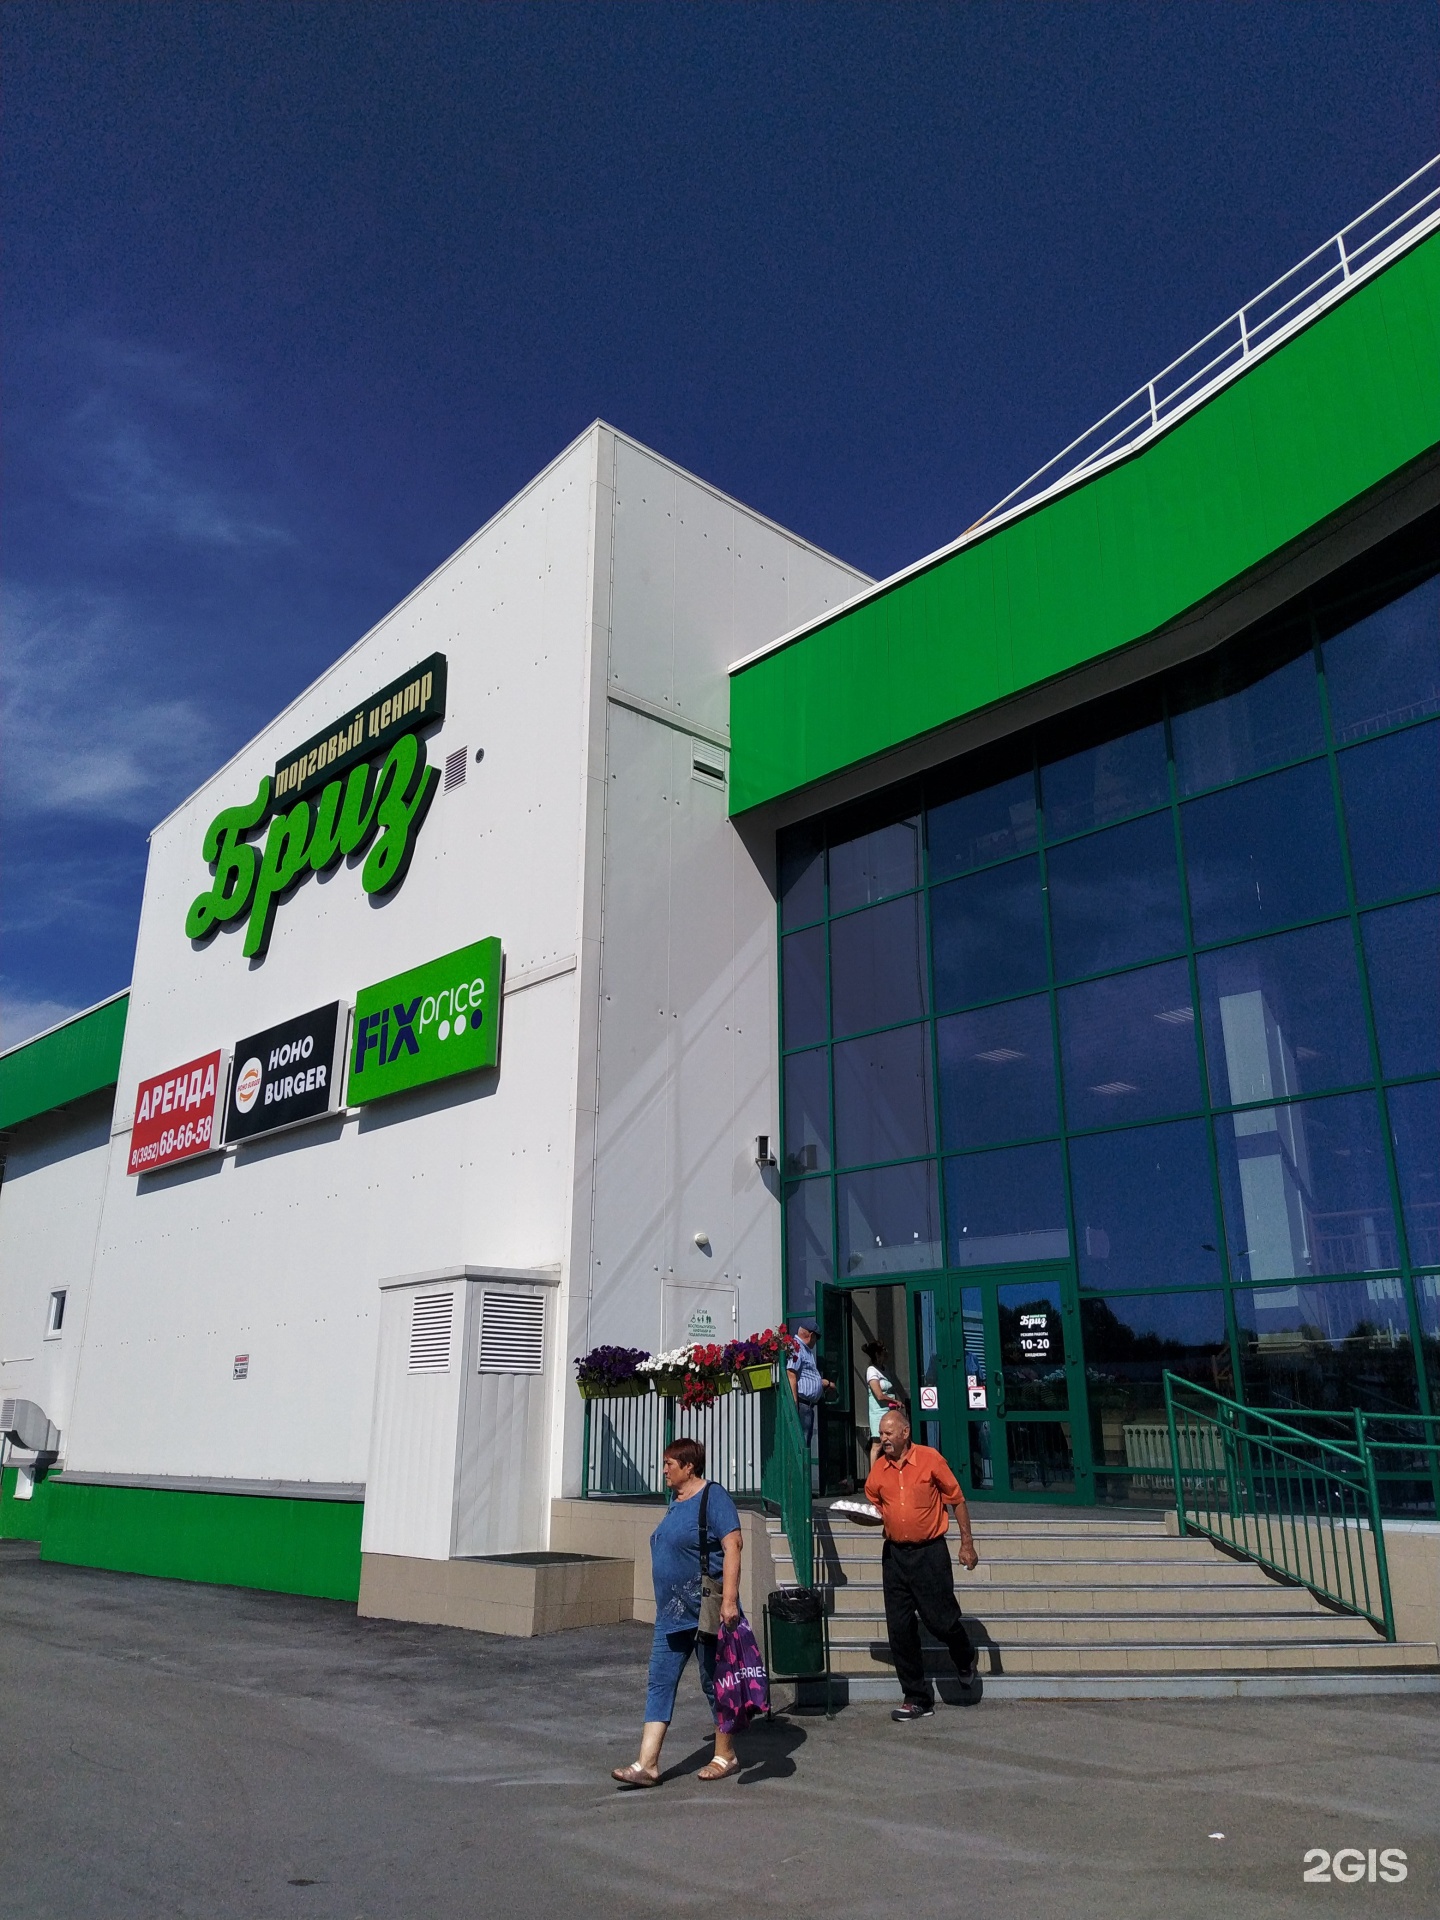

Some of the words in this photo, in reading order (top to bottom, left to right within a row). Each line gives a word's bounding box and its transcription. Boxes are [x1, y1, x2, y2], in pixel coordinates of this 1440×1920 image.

[274, 710, 365, 799] торговый
[368, 670, 433, 738] центр
[185, 733, 434, 958] Бриз
[418, 977, 485, 1035] price
[267, 1035, 314, 1072] HOHO
[137, 1063, 215, 1124] АРЕНДА
[264, 1064, 327, 1106] BURGER
[1020, 1315, 1047, 1328] Бриз
[1021, 1339, 1050, 1349] 10-20
